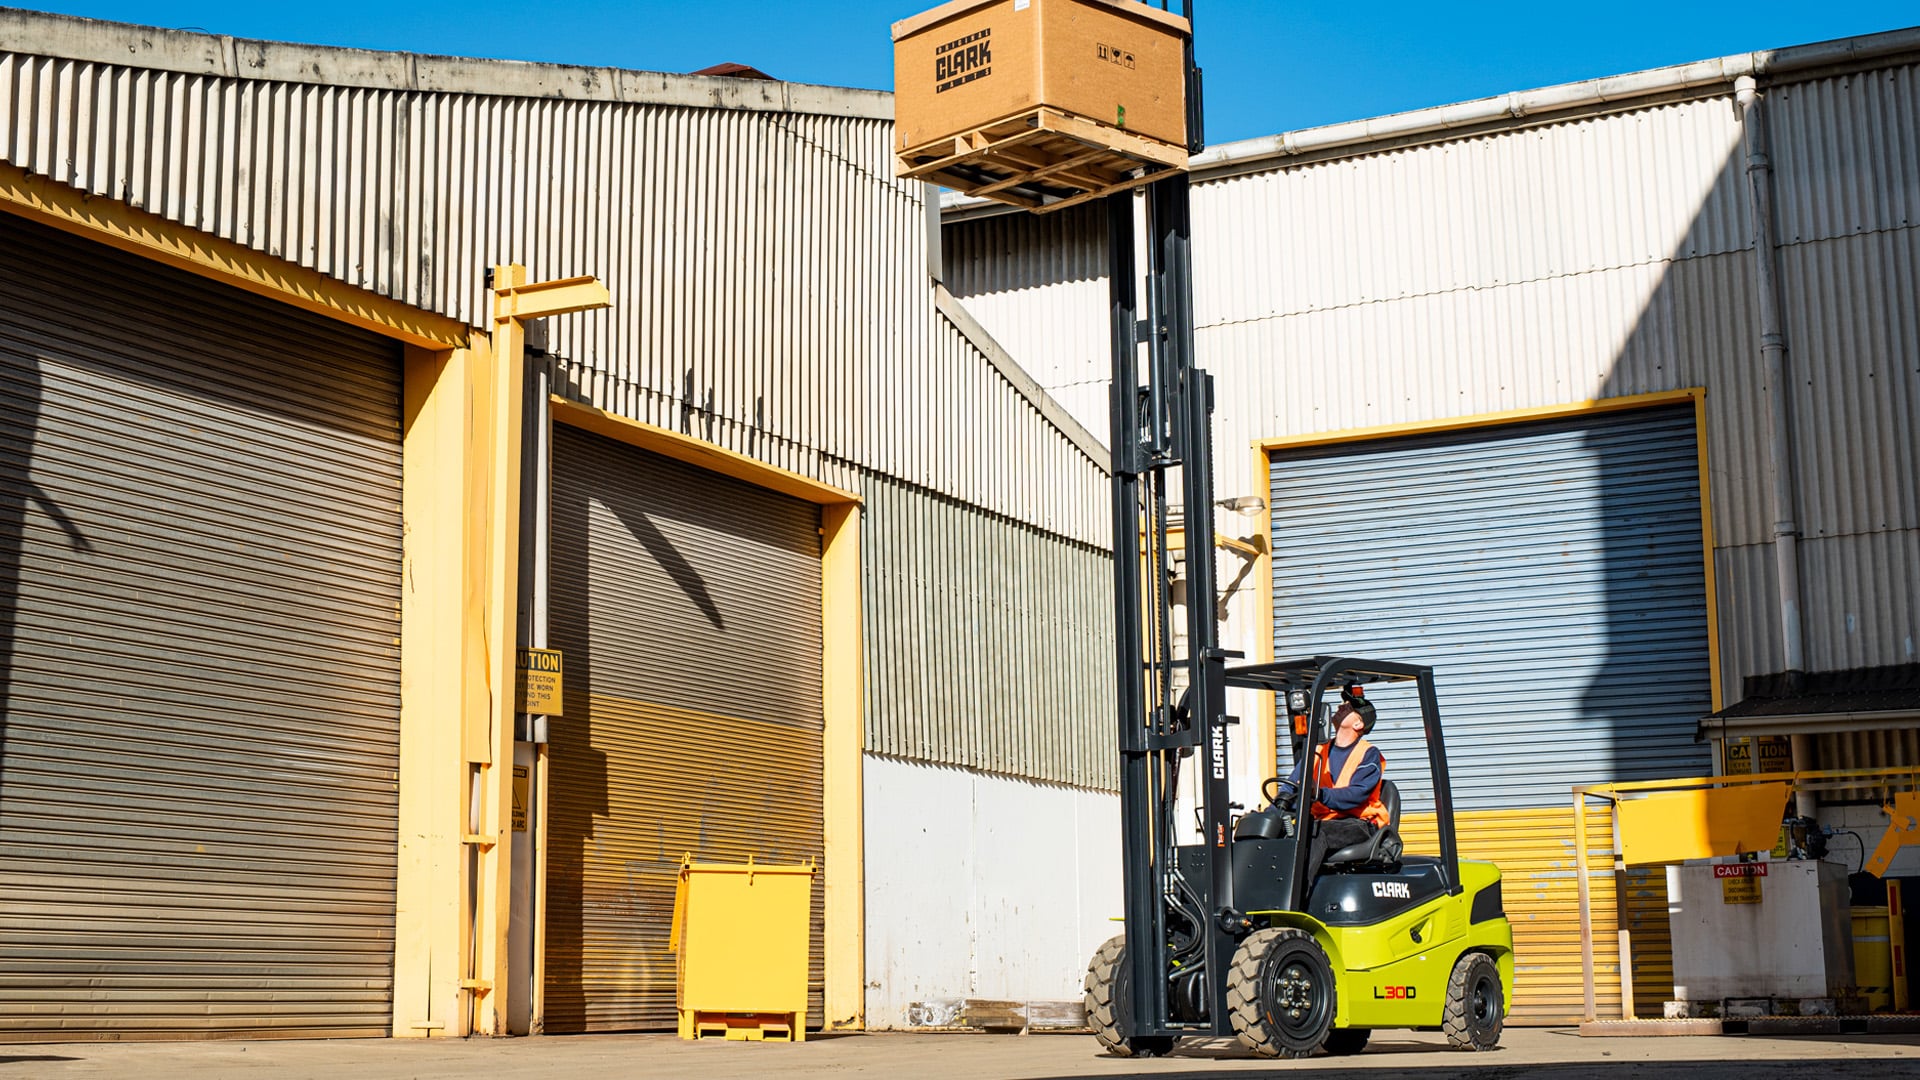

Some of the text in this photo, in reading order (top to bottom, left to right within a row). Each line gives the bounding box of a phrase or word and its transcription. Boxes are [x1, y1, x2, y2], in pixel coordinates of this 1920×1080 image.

[938, 29, 989, 54] ORIGINAL
[936, 40, 991, 82] CLARK
[938, 68, 990, 92] PARTS
[536, 684, 554, 692] WORN
[1212, 725, 1225, 780] CLARK
[1730, 744, 1787, 759] CATION
[1716, 865, 1765, 876] CAUTION
[1371, 881, 1411, 899] CLARK
[1373, 985, 1417, 999] L30D
